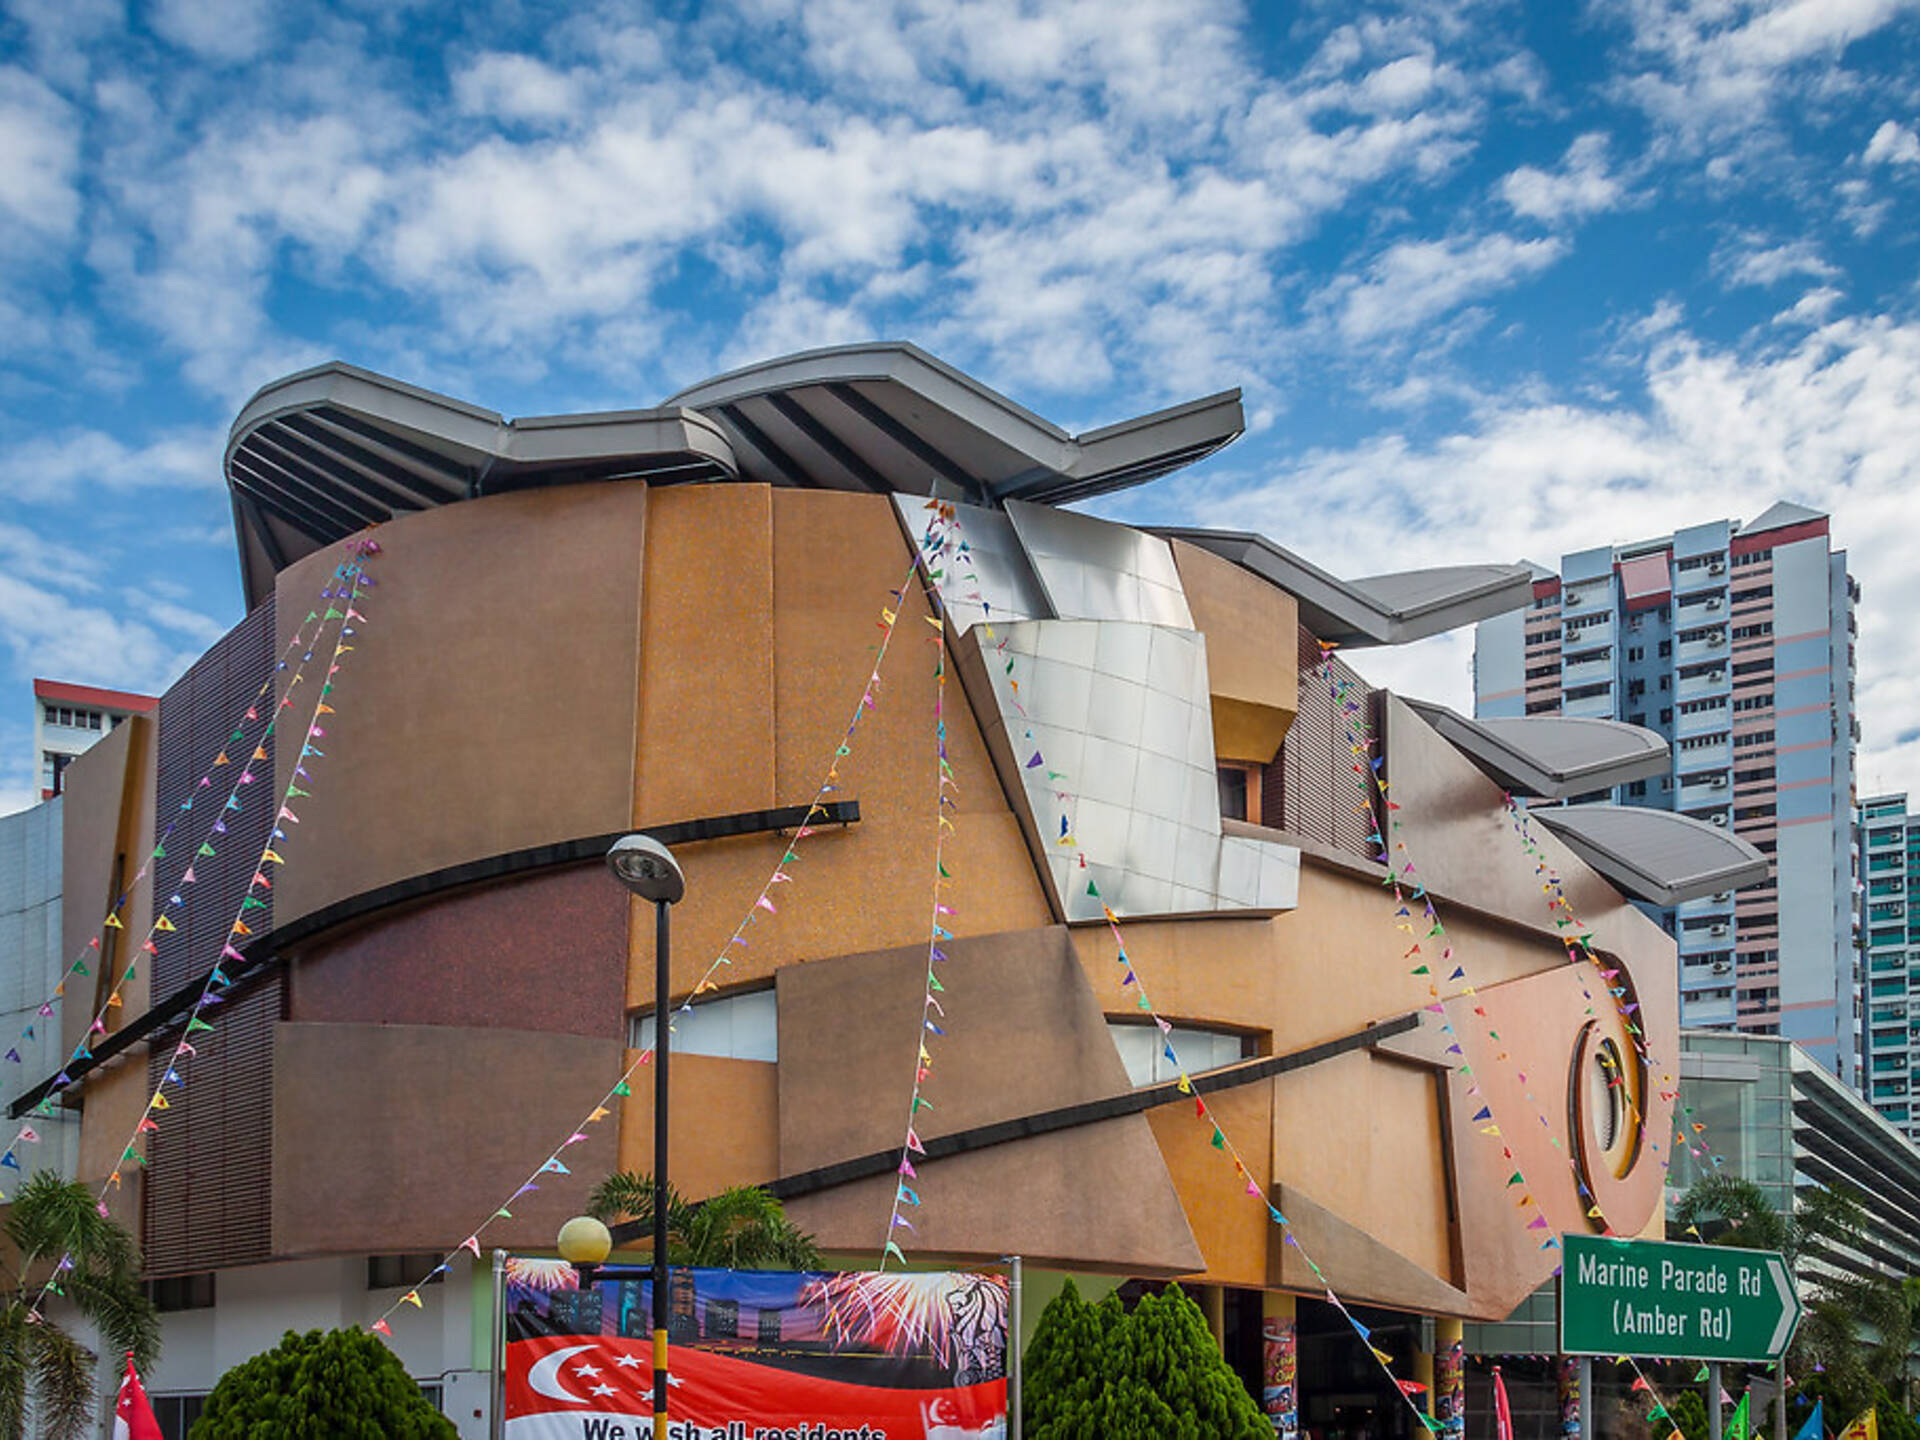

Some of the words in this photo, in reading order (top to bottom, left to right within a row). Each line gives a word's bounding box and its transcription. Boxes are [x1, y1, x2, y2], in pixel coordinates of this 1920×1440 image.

[1578, 1253, 1648, 1289] Marine
[1661, 1260, 1727, 1294] Parade
[1739, 1266, 1761, 1297] Rd
[1613, 1300, 1688, 1336] (Amber
[1700, 1306, 1732, 1341] Rd)
[583, 1418, 625, 1440] We
[635, 1420, 700, 1440] wsh
[711, 1421, 745, 1440] all
[754, 1422, 886, 1440] residents
